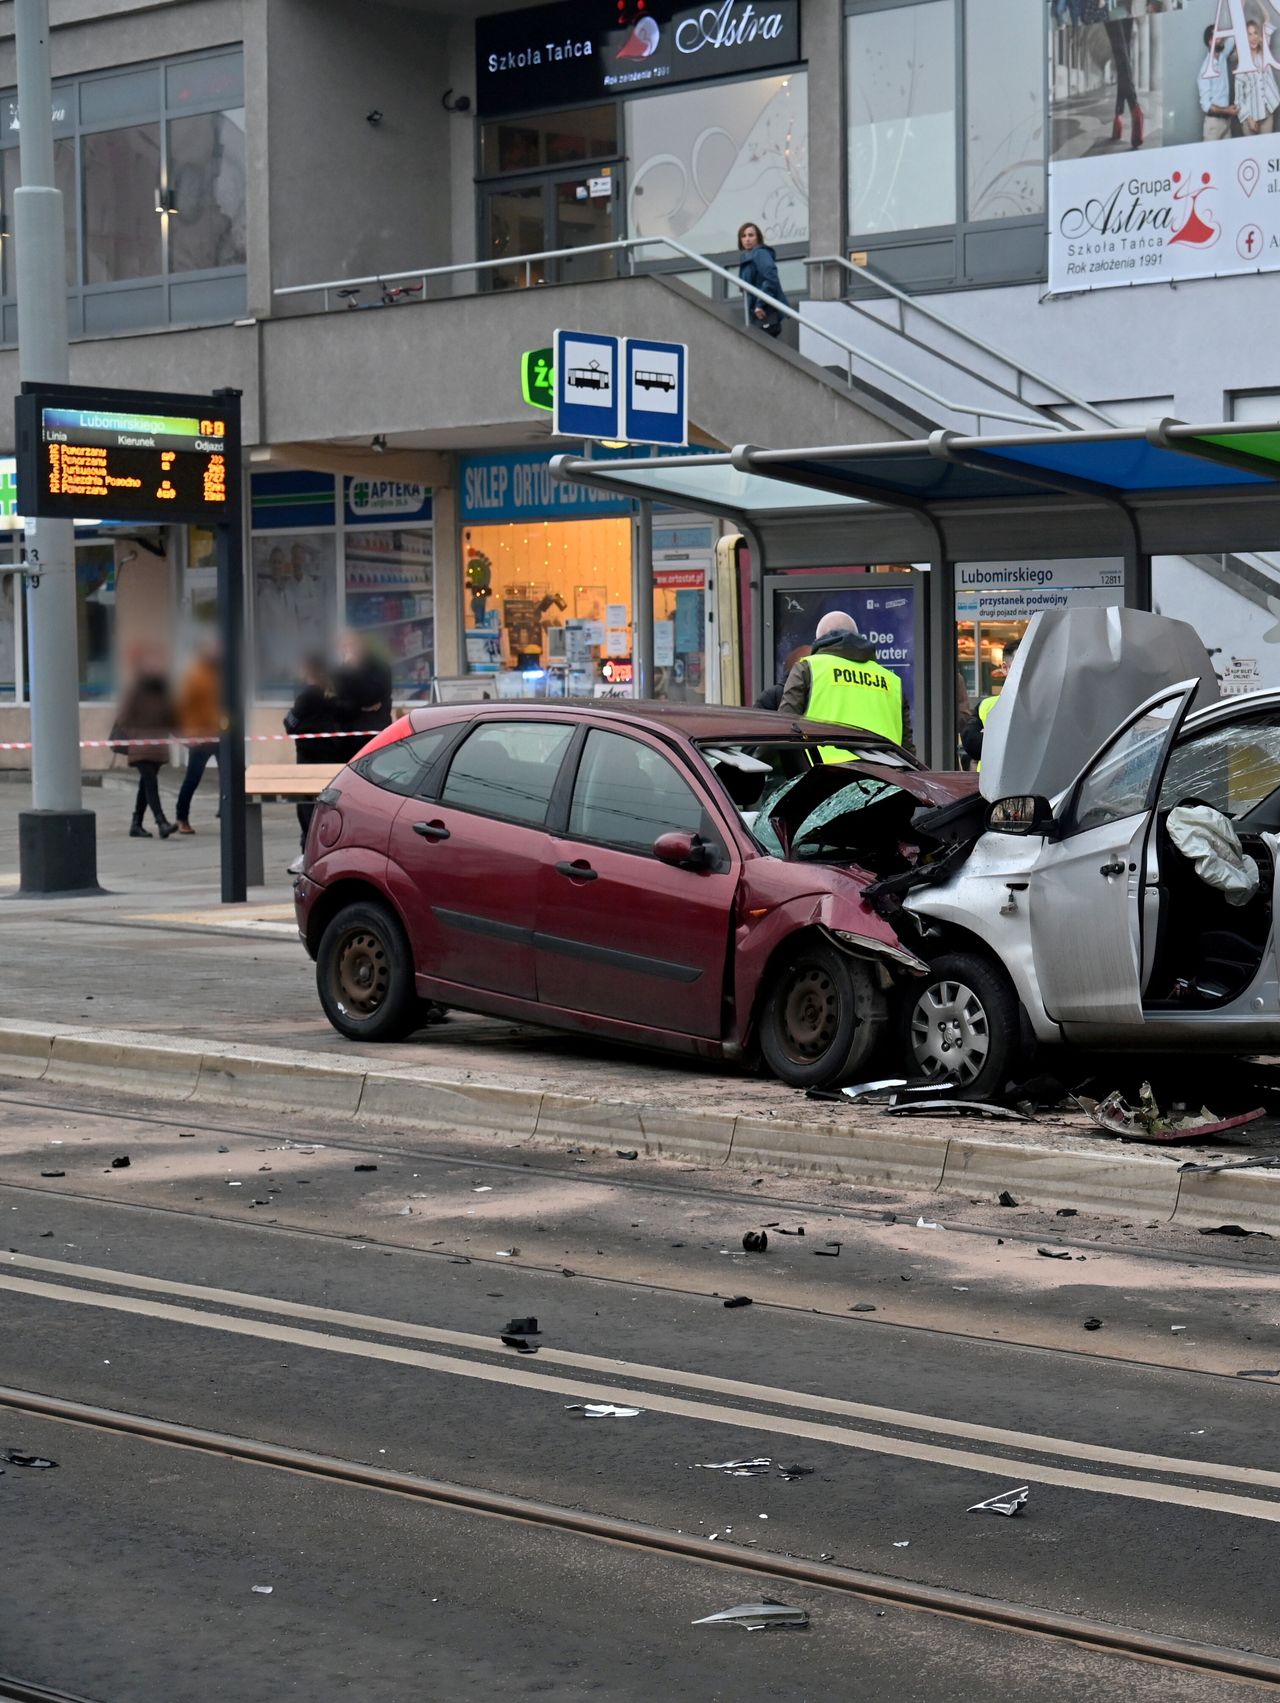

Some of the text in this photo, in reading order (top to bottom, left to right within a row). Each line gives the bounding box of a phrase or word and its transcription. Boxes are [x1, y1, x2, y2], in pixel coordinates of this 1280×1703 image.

[675, 0, 784, 54] Astra
[488, 39, 593, 73] Szkoła Tańca
[603, 73, 617, 86] Rok
[1127, 178, 1171, 197] Grupa
[1267, 177, 1280, 193] al.
[1060, 182, 1174, 240] Astra
[1067, 235, 1164, 257] Szkoła Tańca
[1067, 253, 1163, 275] Rok założenia 1991
[79, 413, 166, 434] Lubomirskiego
[46, 430, 224, 453] Linia Kierunek Odjazd
[371, 481, 421, 498] APTEKA
[465, 464, 507, 510] SKLEP
[961, 567, 1053, 585] Lubomirskiego
[1101, 575, 1121, 585] 12811
[979, 594, 1068, 608] przystanek podwójny
[979, 609, 996, 618] drugi
[997, 609, 1017, 617] pojazd
[1018, 608, 1028, 616] nie
[870, 631, 894, 644] Dee
[833, 668, 889, 691] POLICJA
